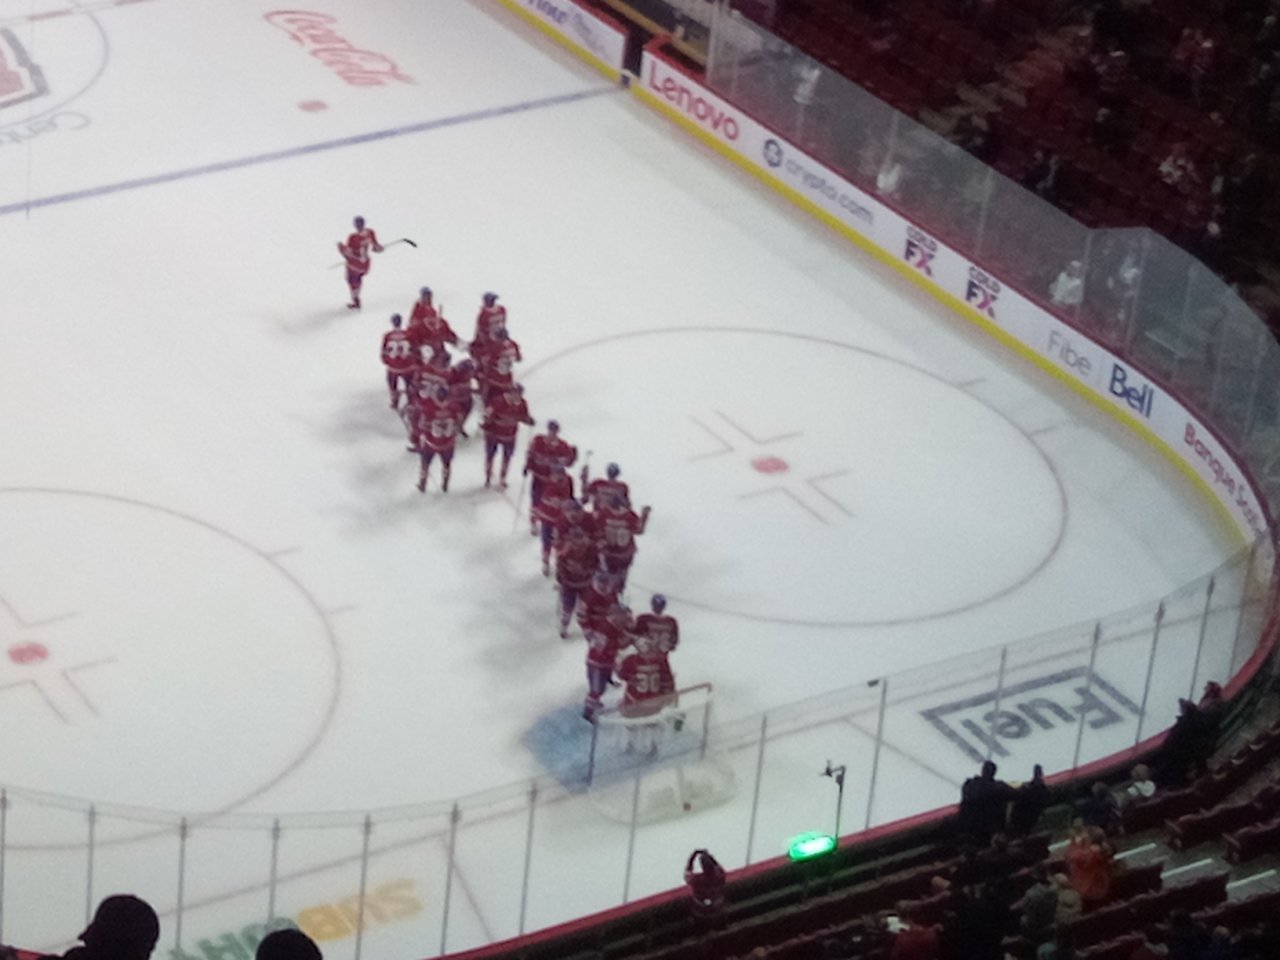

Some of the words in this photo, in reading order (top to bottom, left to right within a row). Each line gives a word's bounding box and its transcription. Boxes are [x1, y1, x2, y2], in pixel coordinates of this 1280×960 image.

[648, 61, 741, 142] Lenovo
[785, 157, 875, 226] crypto.com
[905, 239, 935, 277] FX
[966, 280, 998, 318] FX
[1046, 330, 1094, 377] Fibe
[1109, 363, 1154, 419] Bell
[1184, 422, 1236, 496] Banque
[960, 685, 1124, 758] Fuel
